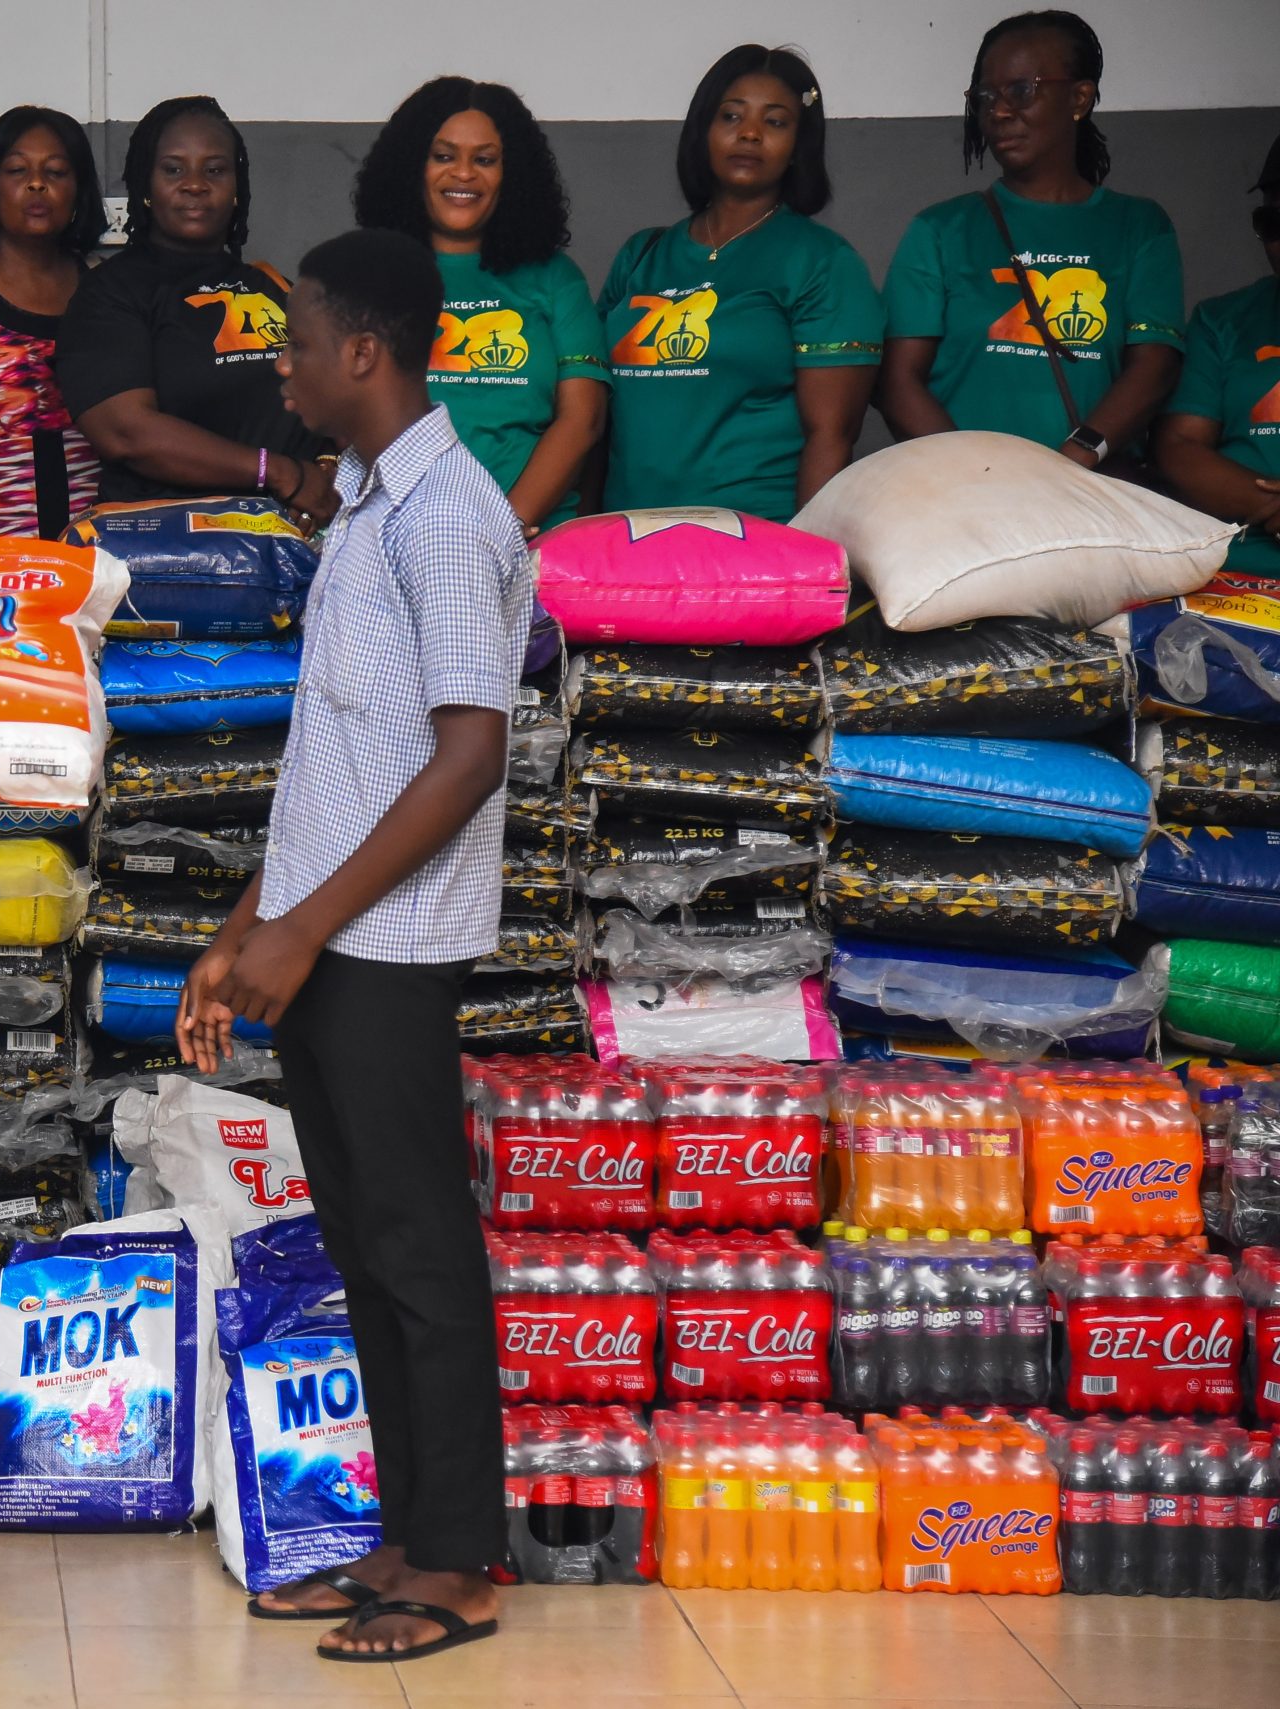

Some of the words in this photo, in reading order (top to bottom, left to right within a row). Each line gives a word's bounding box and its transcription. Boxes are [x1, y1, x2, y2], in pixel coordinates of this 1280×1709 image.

[1036, 254, 1090, 264] ICGC-TRT
[450, 299, 501, 310] ICGC-TRT
[996, 345, 1016, 354] GOD'S
[1017, 347, 1038, 357] GLORY
[215, 357, 225, 365] OF
[226, 353, 244, 363] GOD'S
[245, 352, 263, 362] GLORY
[265, 351, 277, 360] AND
[635, 369, 651, 377] GLORY
[665, 368, 710, 377] FAITHFULNESS
[441, 375, 464, 384] GLORY
[466, 376, 478, 384] AND
[480, 375, 529, 385] FAITHFULNESS
[1257, 427, 1277, 435] GOD'S
[702, 828, 725, 838] KG
[187, 866, 209, 876] KG
[222, 1124, 263, 1137] NEW
[225, 1135, 265, 1145] NOUVEAU
[1092, 1155, 1112, 1166] BEL
[1055, 1154, 1194, 1203] Squeeze
[1131, 1189, 1179, 1203] Orange
[140, 1279, 168, 1291] NEW
[840, 1310, 879, 1331] Bigoo
[881, 1308, 919, 1328] Bigoo
[923, 1309, 962, 1329] Bigoo
[19, 1301, 144, 1378] MOK
[36, 1378, 63, 1389] MULTI
[64, 1367, 109, 1386] FUNCTION
[1213, 1387, 1236, 1395] 350ML
[275, 1367, 369, 1434] MO
[299, 1428, 326, 1441] MULTI
[951, 1506, 970, 1517] BEL
[1154, 1508, 1176, 1517] Cola
[910, 1506, 1055, 1559] Squeeze
[989, 1540, 1040, 1556] Orange
